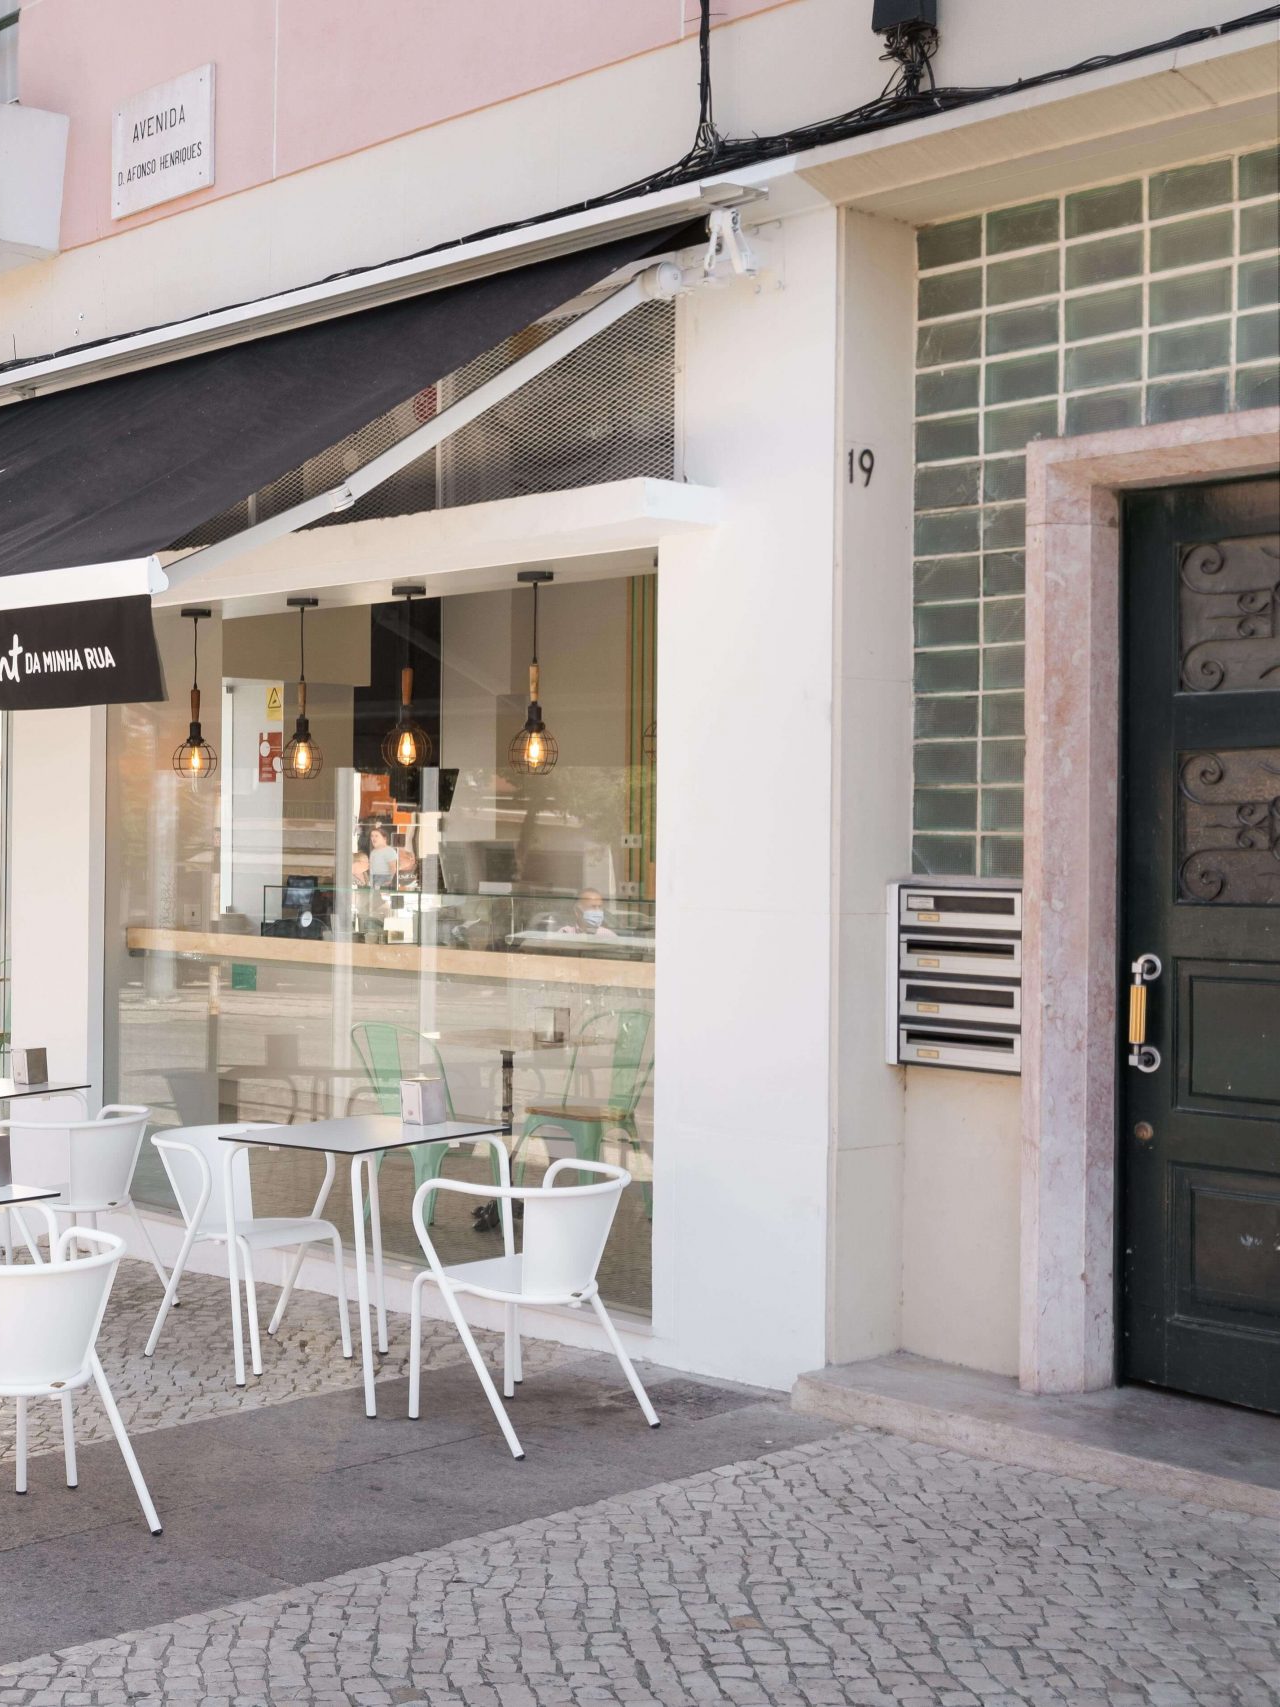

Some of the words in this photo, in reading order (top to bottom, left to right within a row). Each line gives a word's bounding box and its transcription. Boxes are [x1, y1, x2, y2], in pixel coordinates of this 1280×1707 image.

[132, 103, 186, 143] AVENIDA
[117, 171, 125, 187] D.
[126, 158, 157, 184] AFONSO
[159, 141, 203, 171] HENRIQUES
[847, 447, 874, 487] 19
[25, 652, 41, 674] DA
[43, 649, 84, 673] MINHA
[84, 646, 116, 669] RUA
